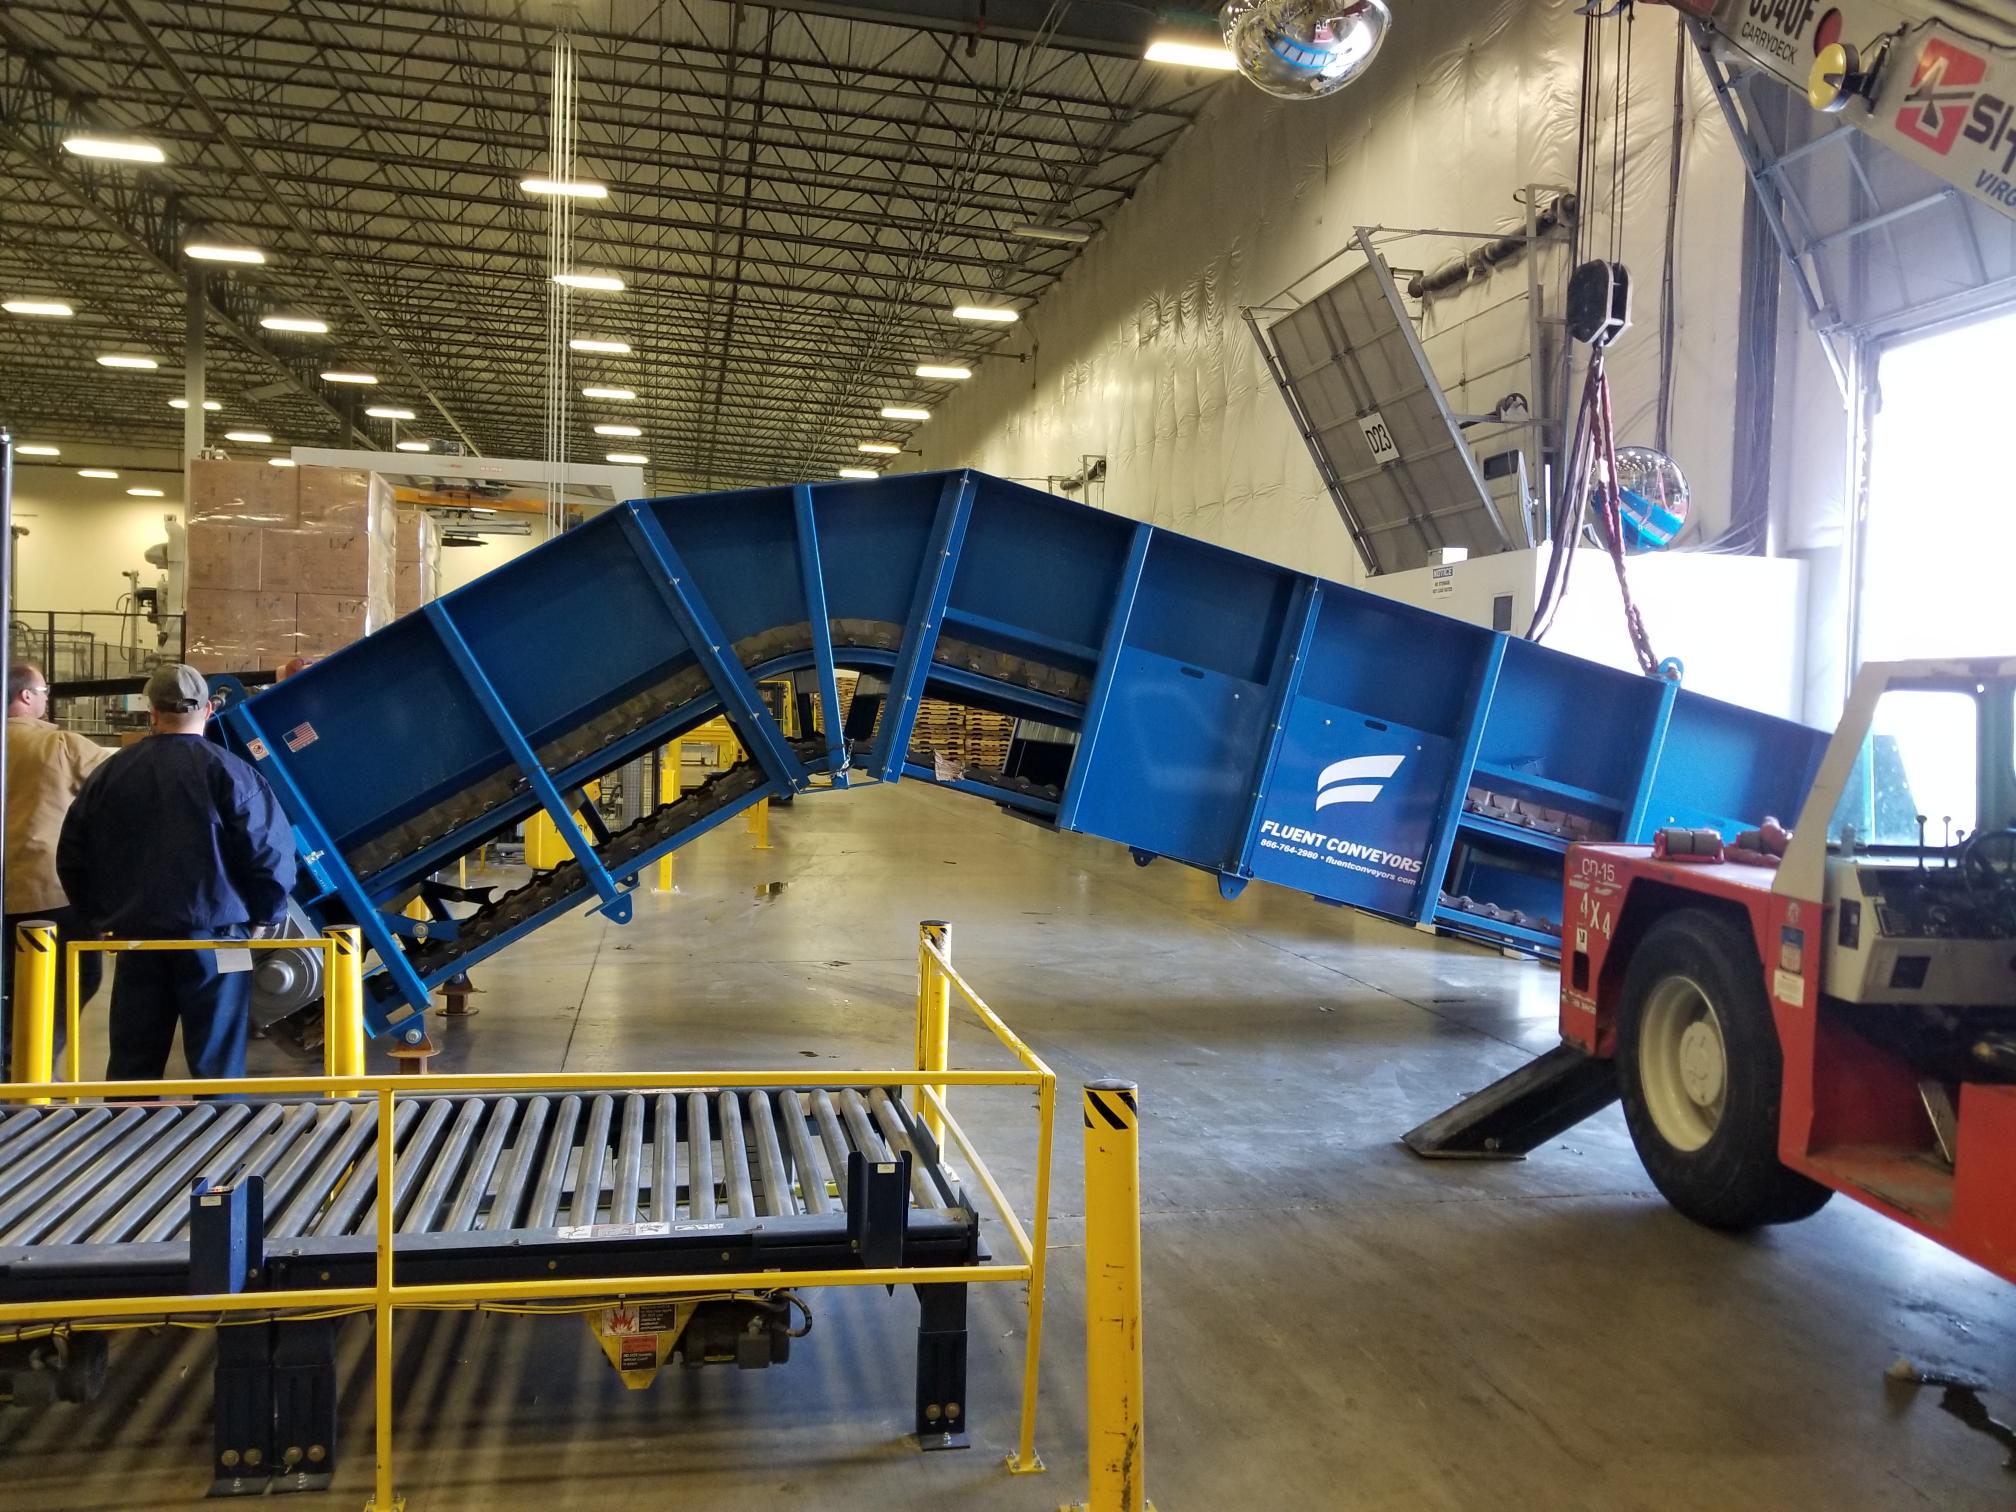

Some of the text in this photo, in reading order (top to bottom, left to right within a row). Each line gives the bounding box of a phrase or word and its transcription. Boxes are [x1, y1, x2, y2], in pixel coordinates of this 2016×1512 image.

[1741, 21, 1798, 65] CARRYDECK
[1364, 423, 1392, 454] D23
[1260, 820, 1423, 873] FLUENT CONVEYORS
[1260, 838, 1417, 886] 866-764-2980 fluentconveyorscom
